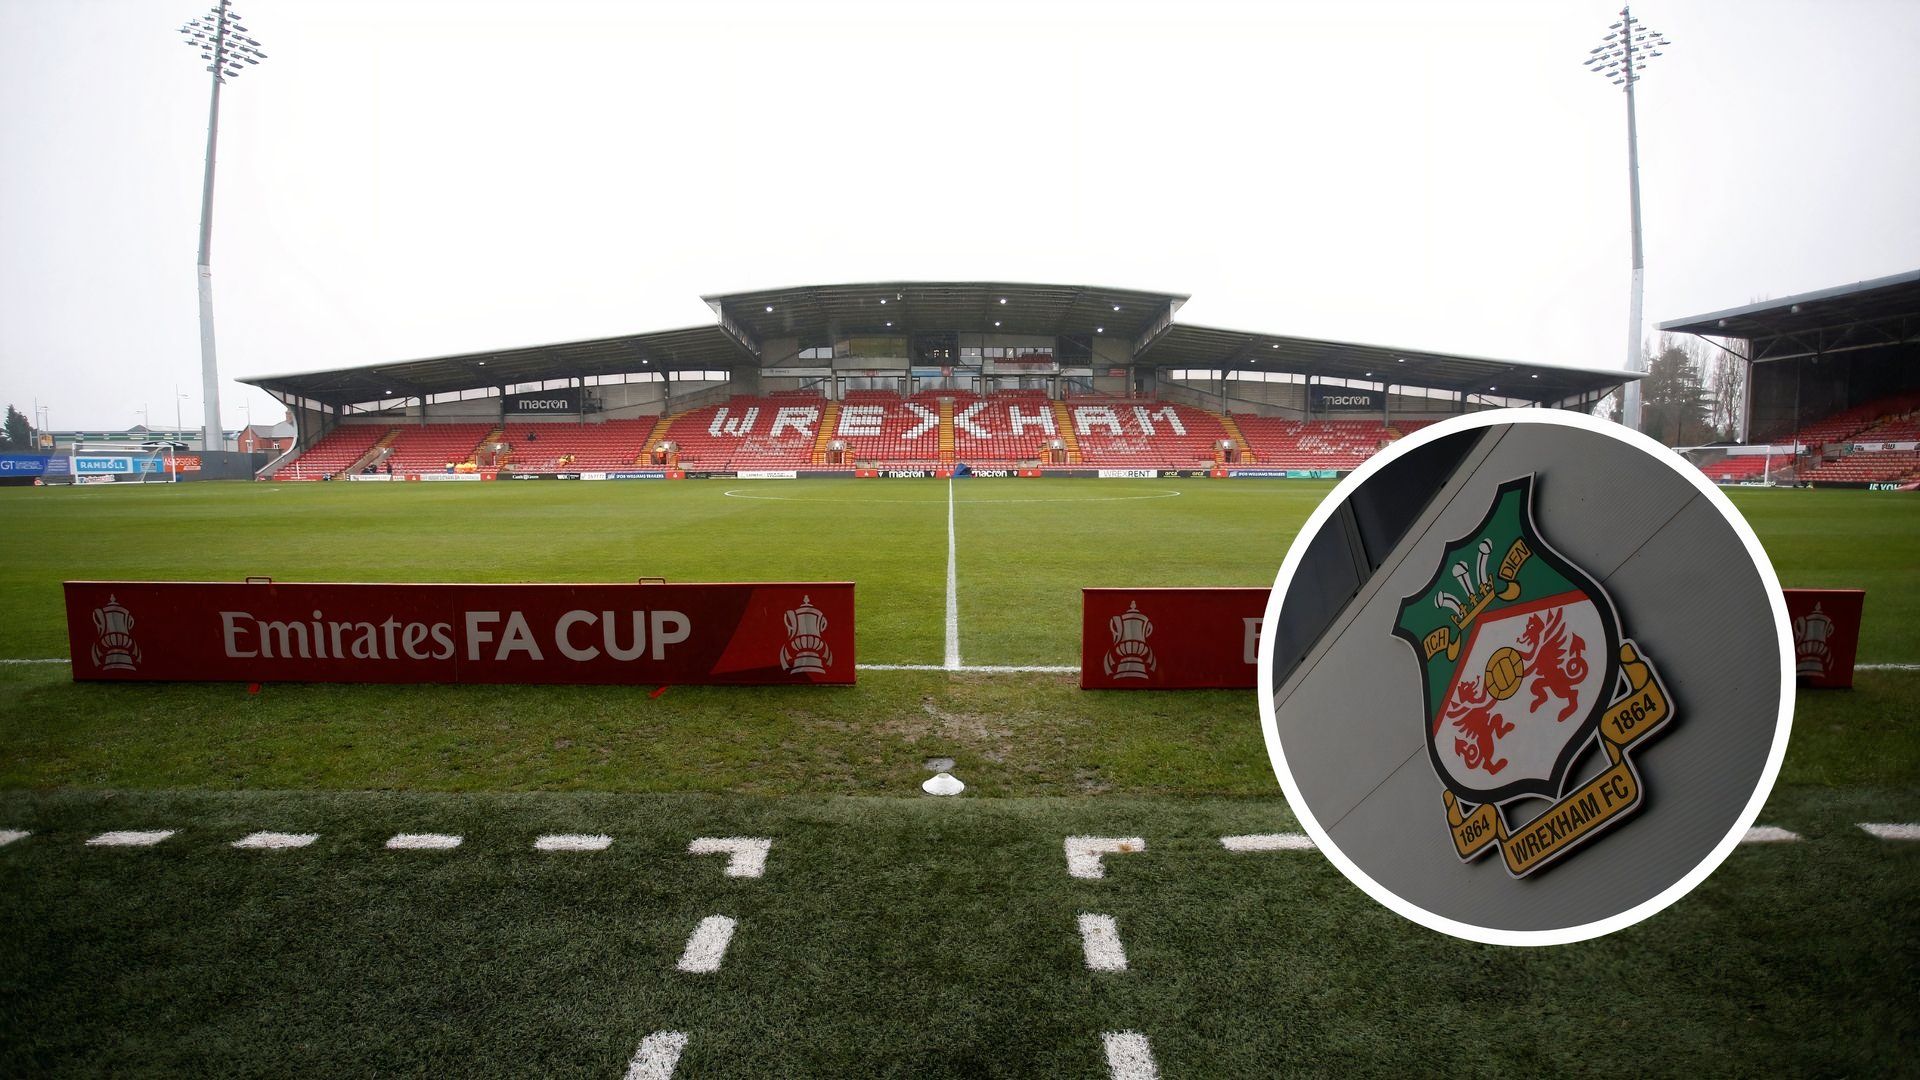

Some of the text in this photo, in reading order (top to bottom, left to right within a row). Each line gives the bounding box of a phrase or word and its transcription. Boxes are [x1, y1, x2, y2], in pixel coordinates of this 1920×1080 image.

[519, 399, 568, 409] macron
[1322, 396, 1370, 405] macron
[708, 402, 1187, 438] WREXHAM
[80, 460, 125, 469] RAMBOLL
[888, 470, 924, 478] macron
[972, 470, 1007, 478] macron
[1425, 542, 1529, 655] ICH DIEN
[220, 609, 691, 662] Emirates FA CUP
[1612, 692, 1656, 735] 1864
[1459, 813, 1490, 847] 1864
[1511, 774, 1629, 866] WREXHAM FC
